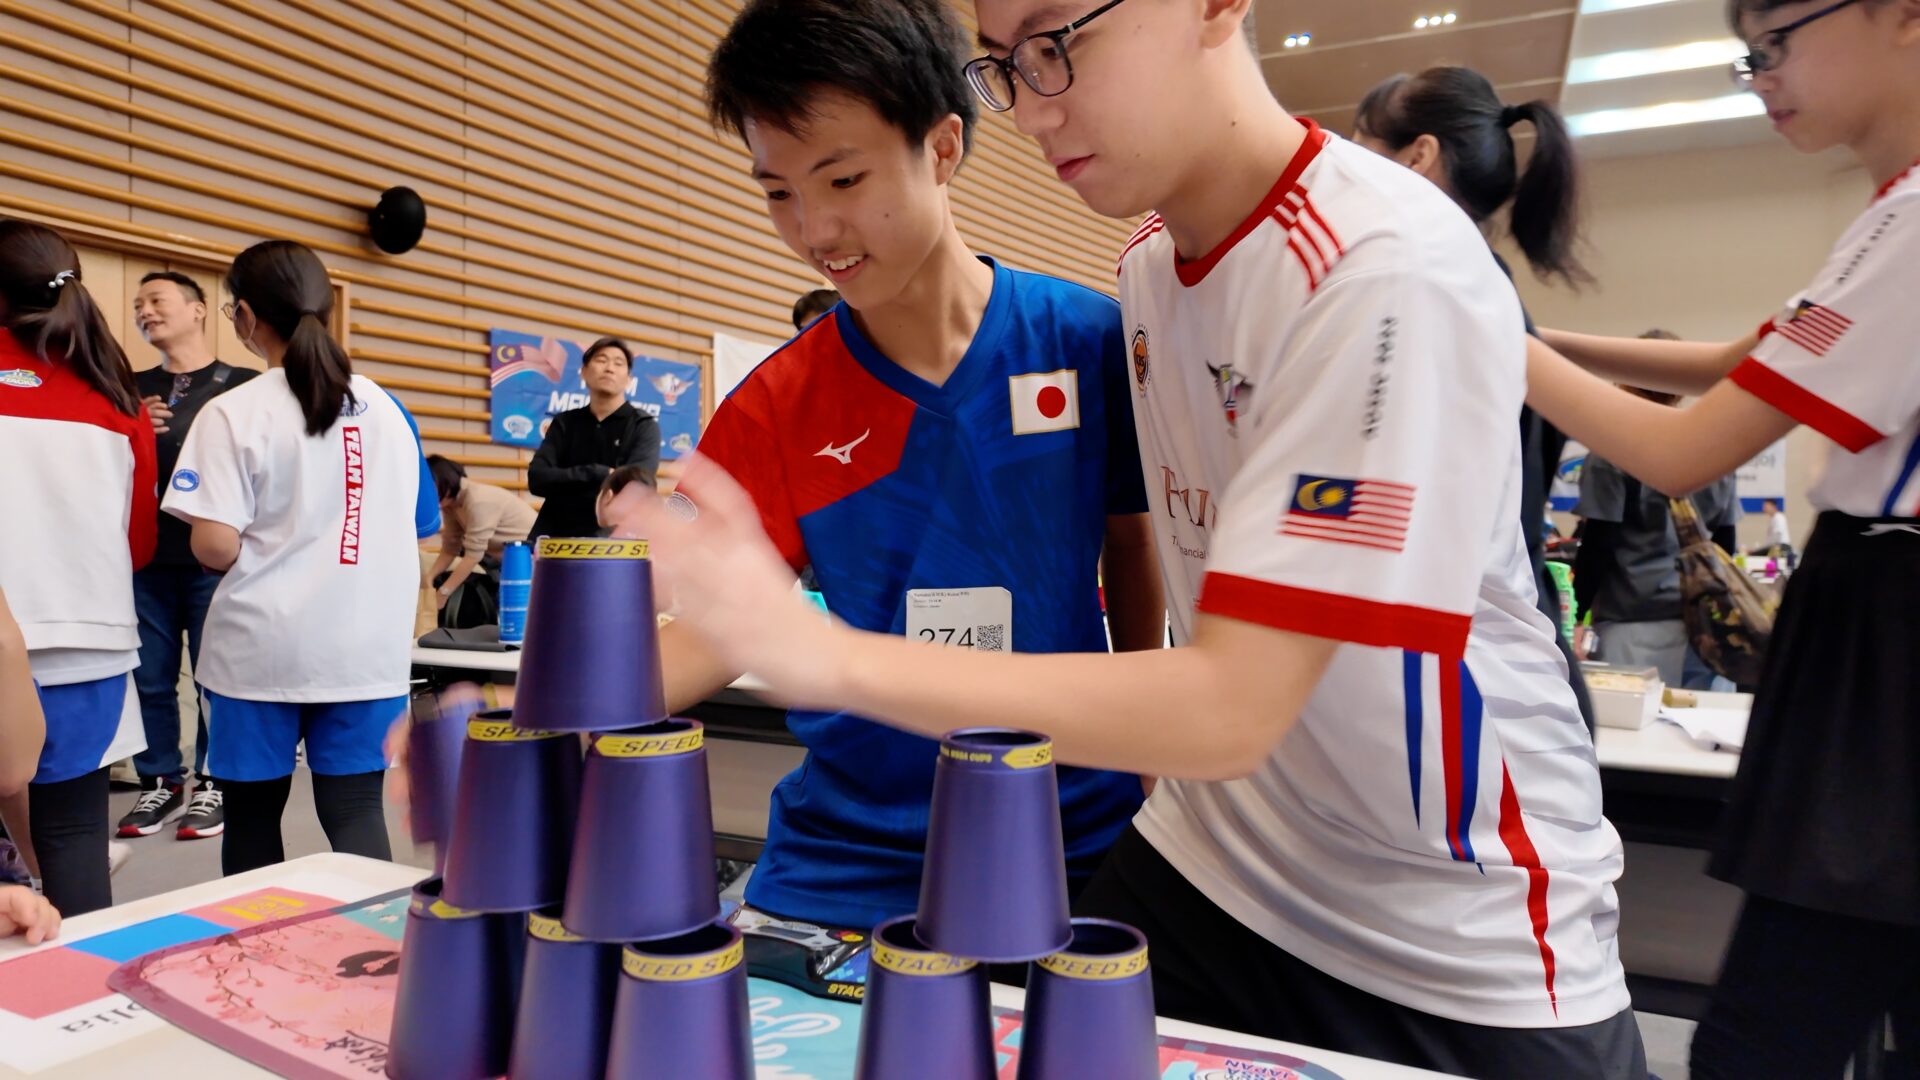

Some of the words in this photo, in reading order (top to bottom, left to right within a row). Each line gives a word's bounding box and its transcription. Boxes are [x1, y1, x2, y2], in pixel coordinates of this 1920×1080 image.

[345, 431, 363, 484] TEAM
[341, 487, 362, 562] TAIWAN
[544, 543, 624, 555] SPEED
[919, 627, 975, 651] 274
[622, 735, 698, 753] SPEED
[1225, 1059, 1289, 1079] JAPAN
